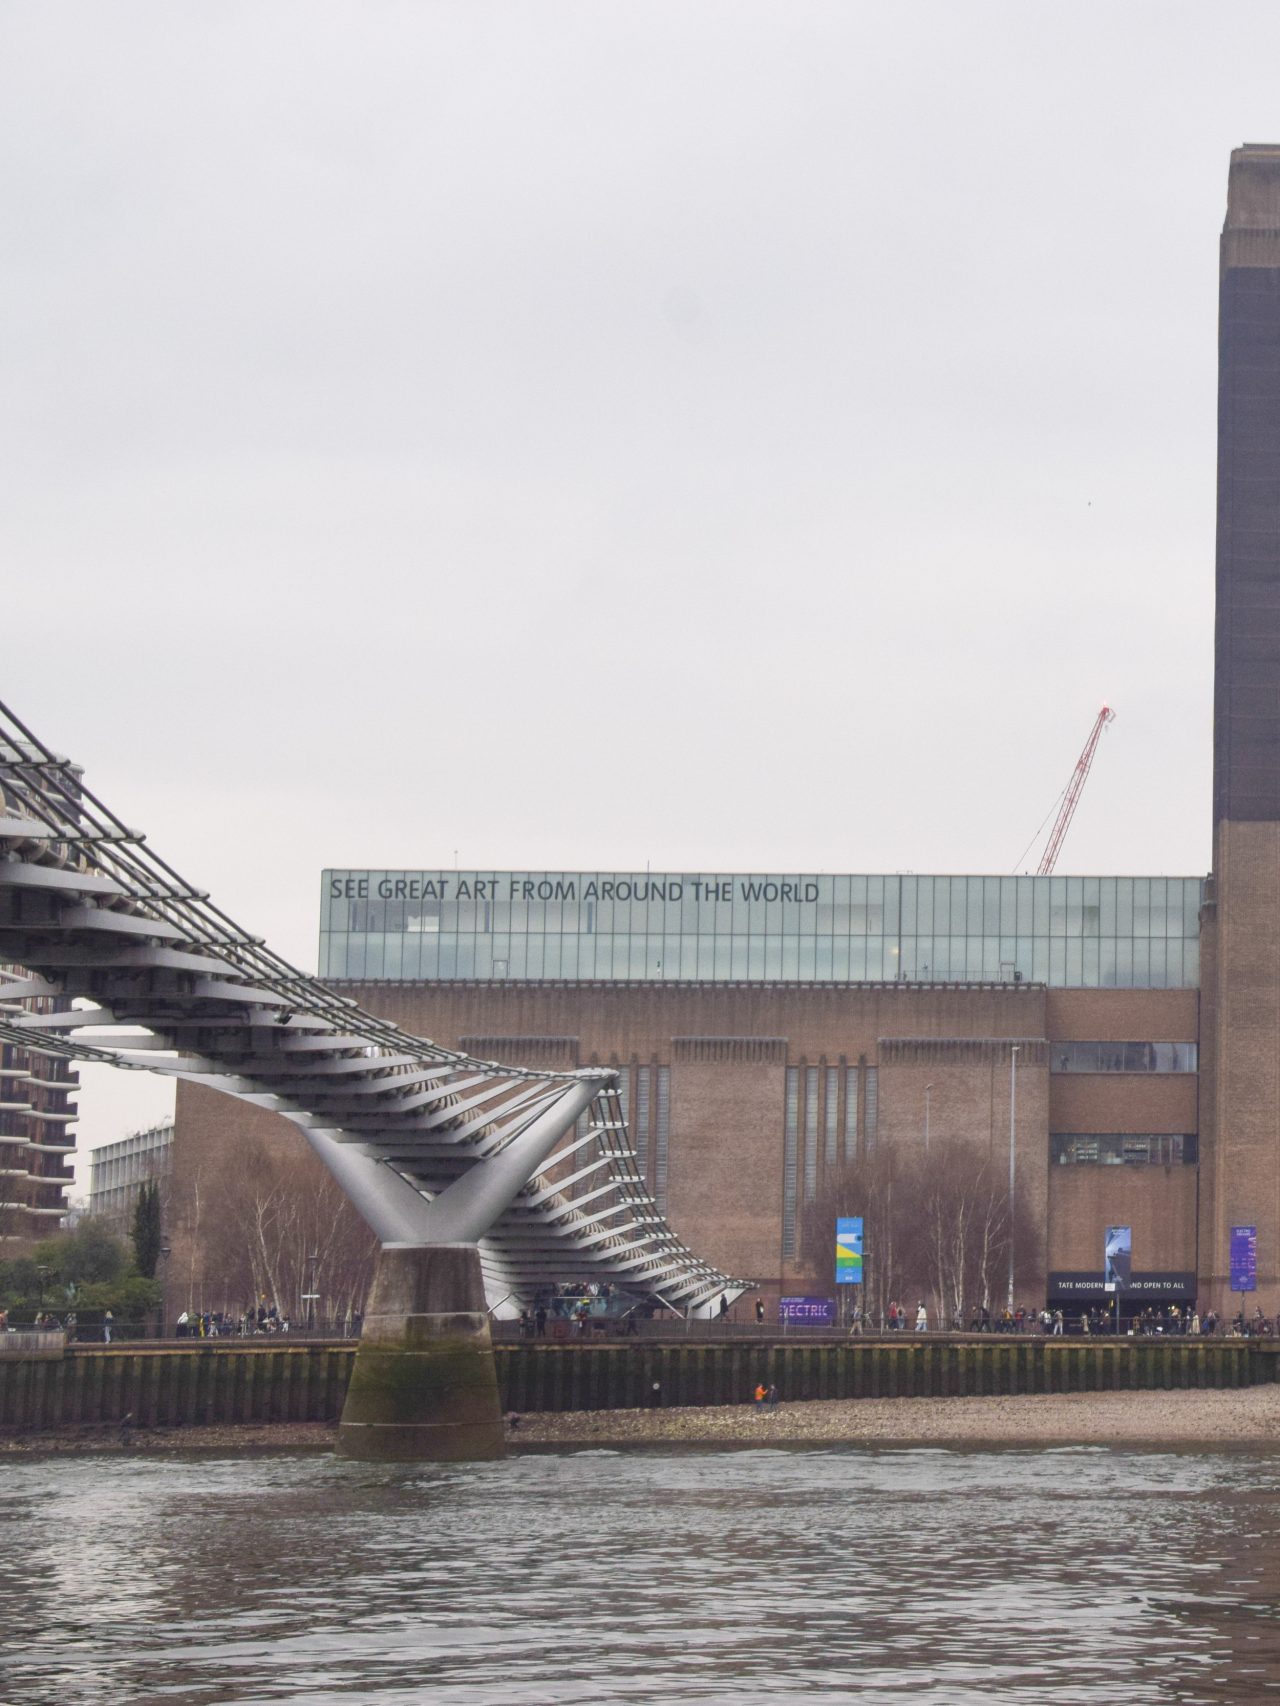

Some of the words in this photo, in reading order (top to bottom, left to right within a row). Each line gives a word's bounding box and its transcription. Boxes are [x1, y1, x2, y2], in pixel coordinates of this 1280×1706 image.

[330, 879, 369, 899] SEE
[377, 879, 449, 900] GREAT
[455, 880, 499, 901] ART
[510, 881, 575, 901] FROM
[584, 881, 683, 902] AROUND
[691, 882, 732, 902] THE
[741, 882, 819, 903] WORLD
